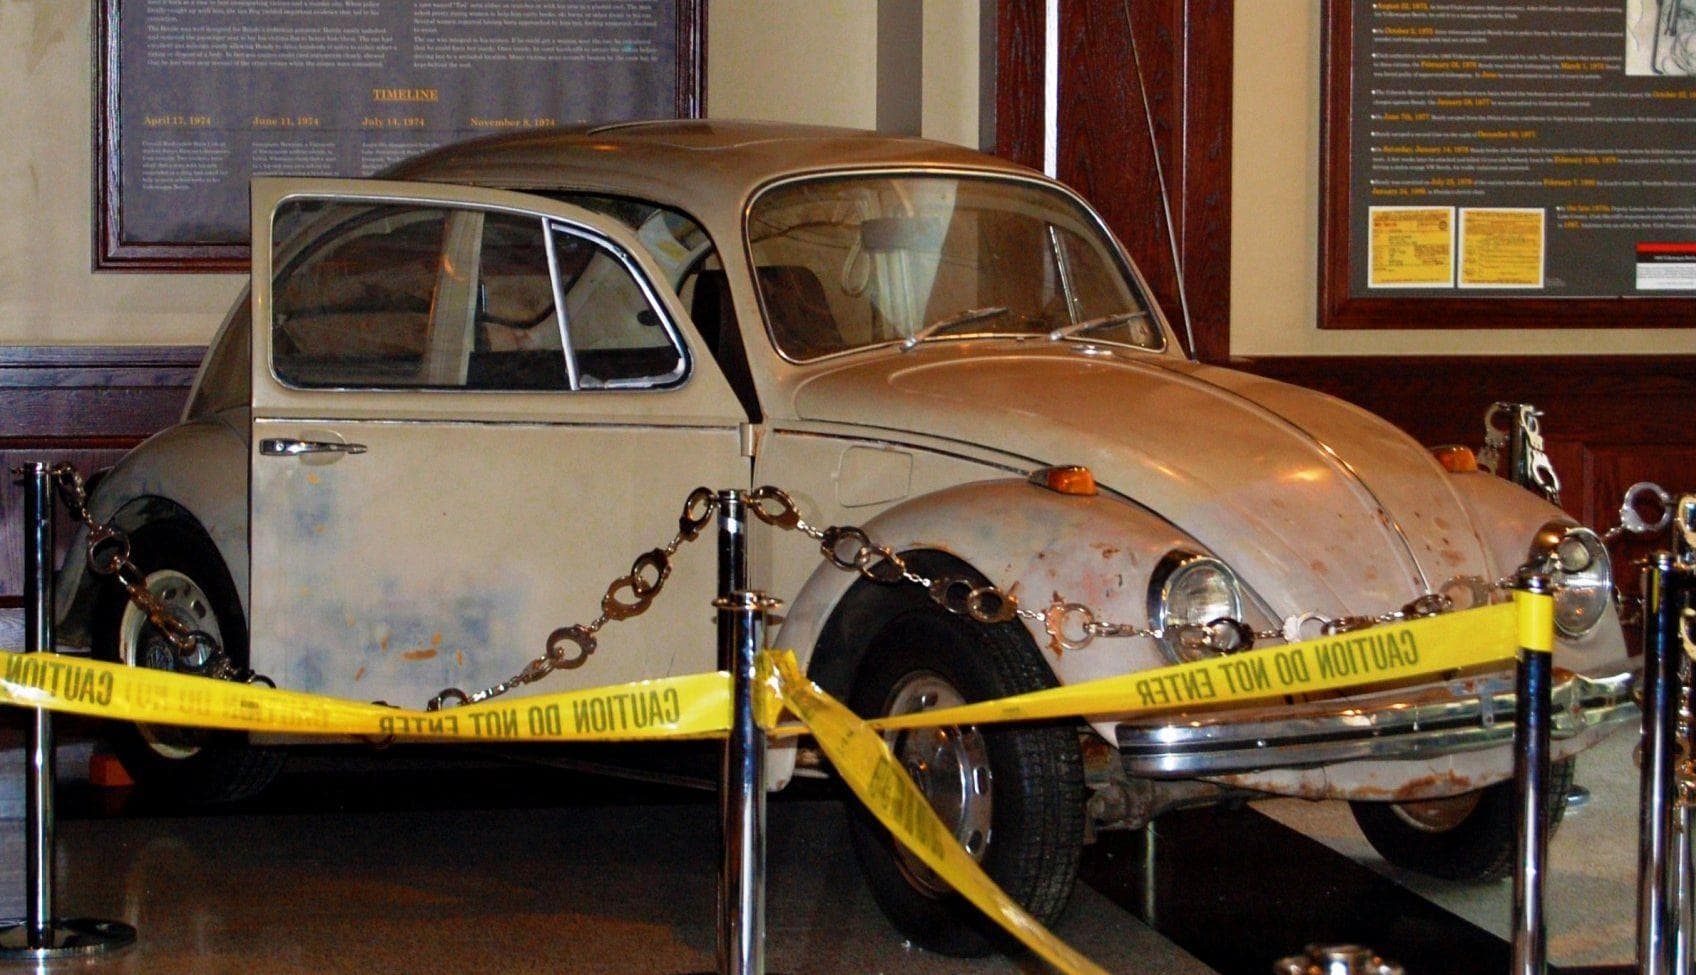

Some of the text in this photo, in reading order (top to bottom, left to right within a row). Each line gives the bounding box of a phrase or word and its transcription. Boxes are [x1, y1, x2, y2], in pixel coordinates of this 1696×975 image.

[373, 89, 439, 101] TIMELINE
[144, 116, 170, 126] April
[189, 116, 211, 125] 1974
[252, 117, 277, 126] June
[297, 117, 319, 126] 1974
[361, 117, 384, 127] July
[470, 118, 521, 127] November
